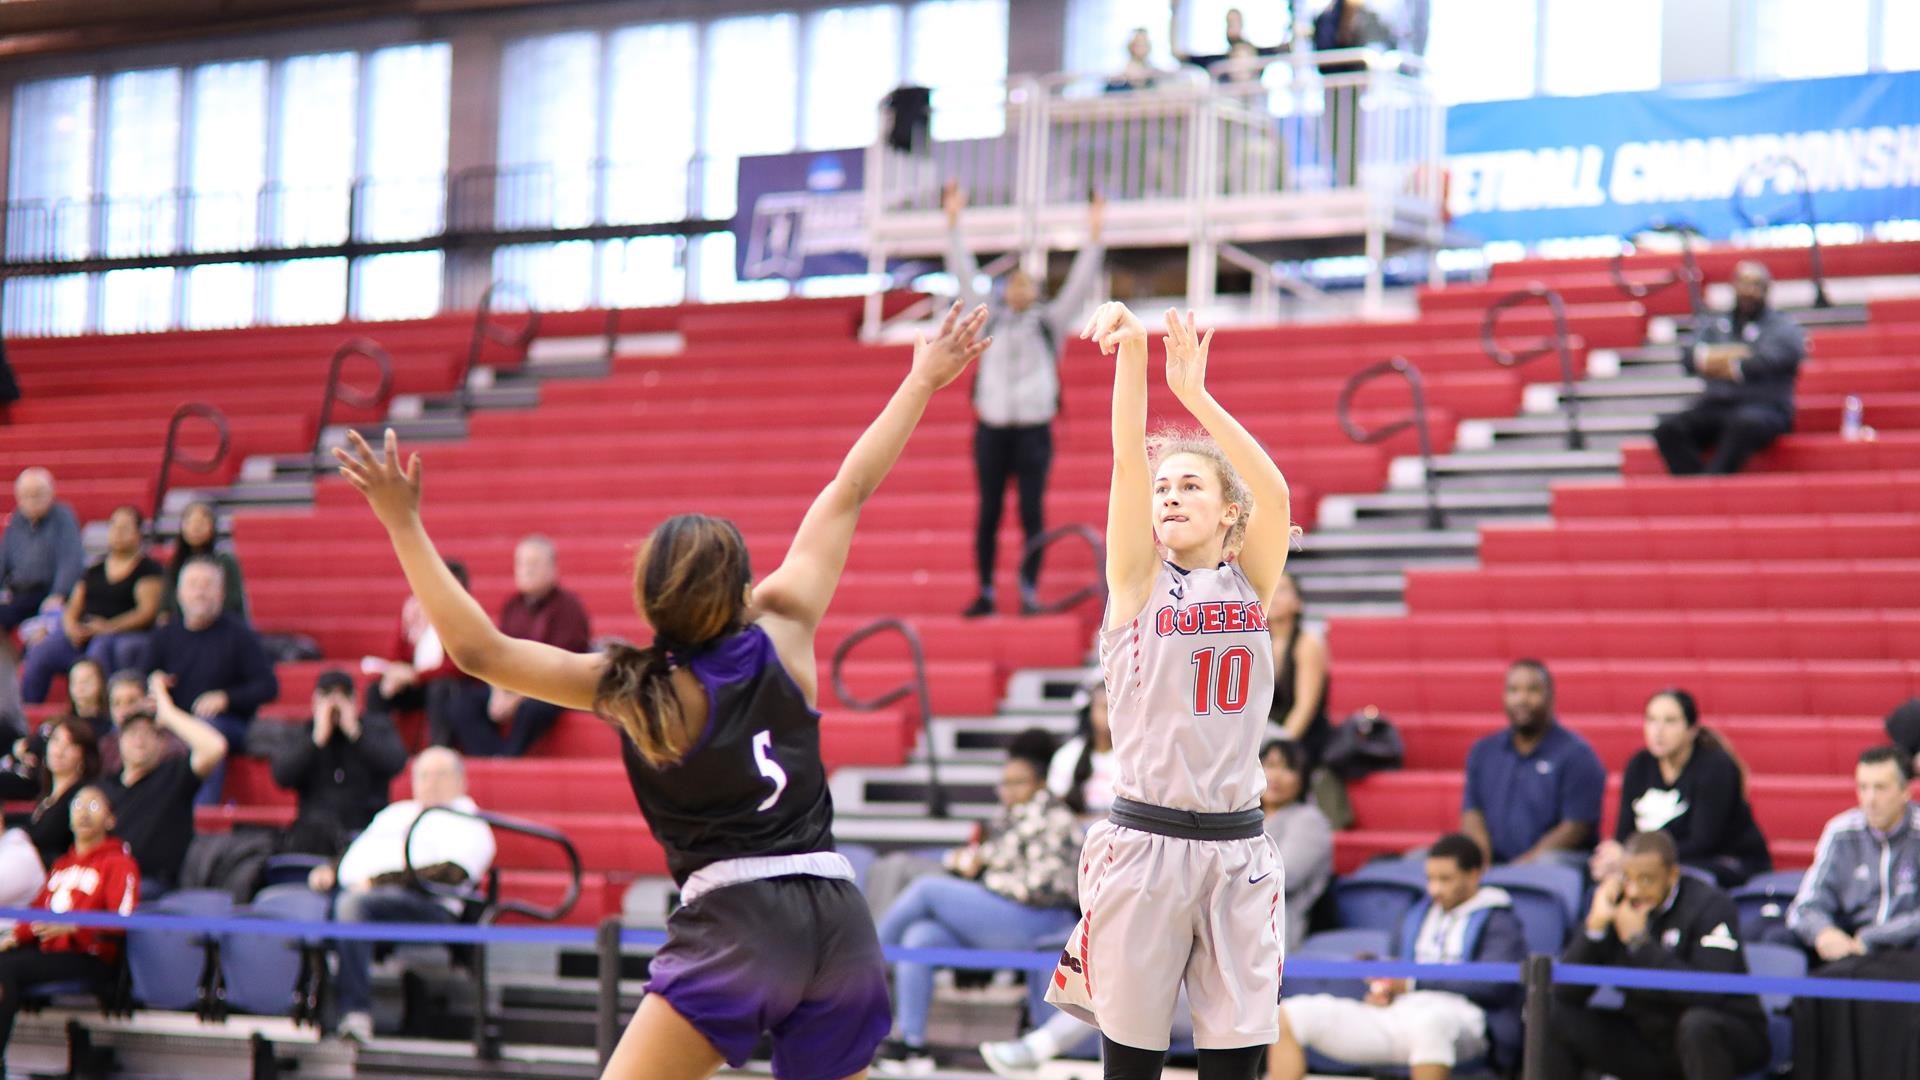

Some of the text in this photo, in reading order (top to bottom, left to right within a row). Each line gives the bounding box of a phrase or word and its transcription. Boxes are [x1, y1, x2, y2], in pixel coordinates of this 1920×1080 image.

[1446, 144, 1606, 216] ETBALL
[1191, 645, 1253, 716] 10
[753, 730, 787, 812] 5
